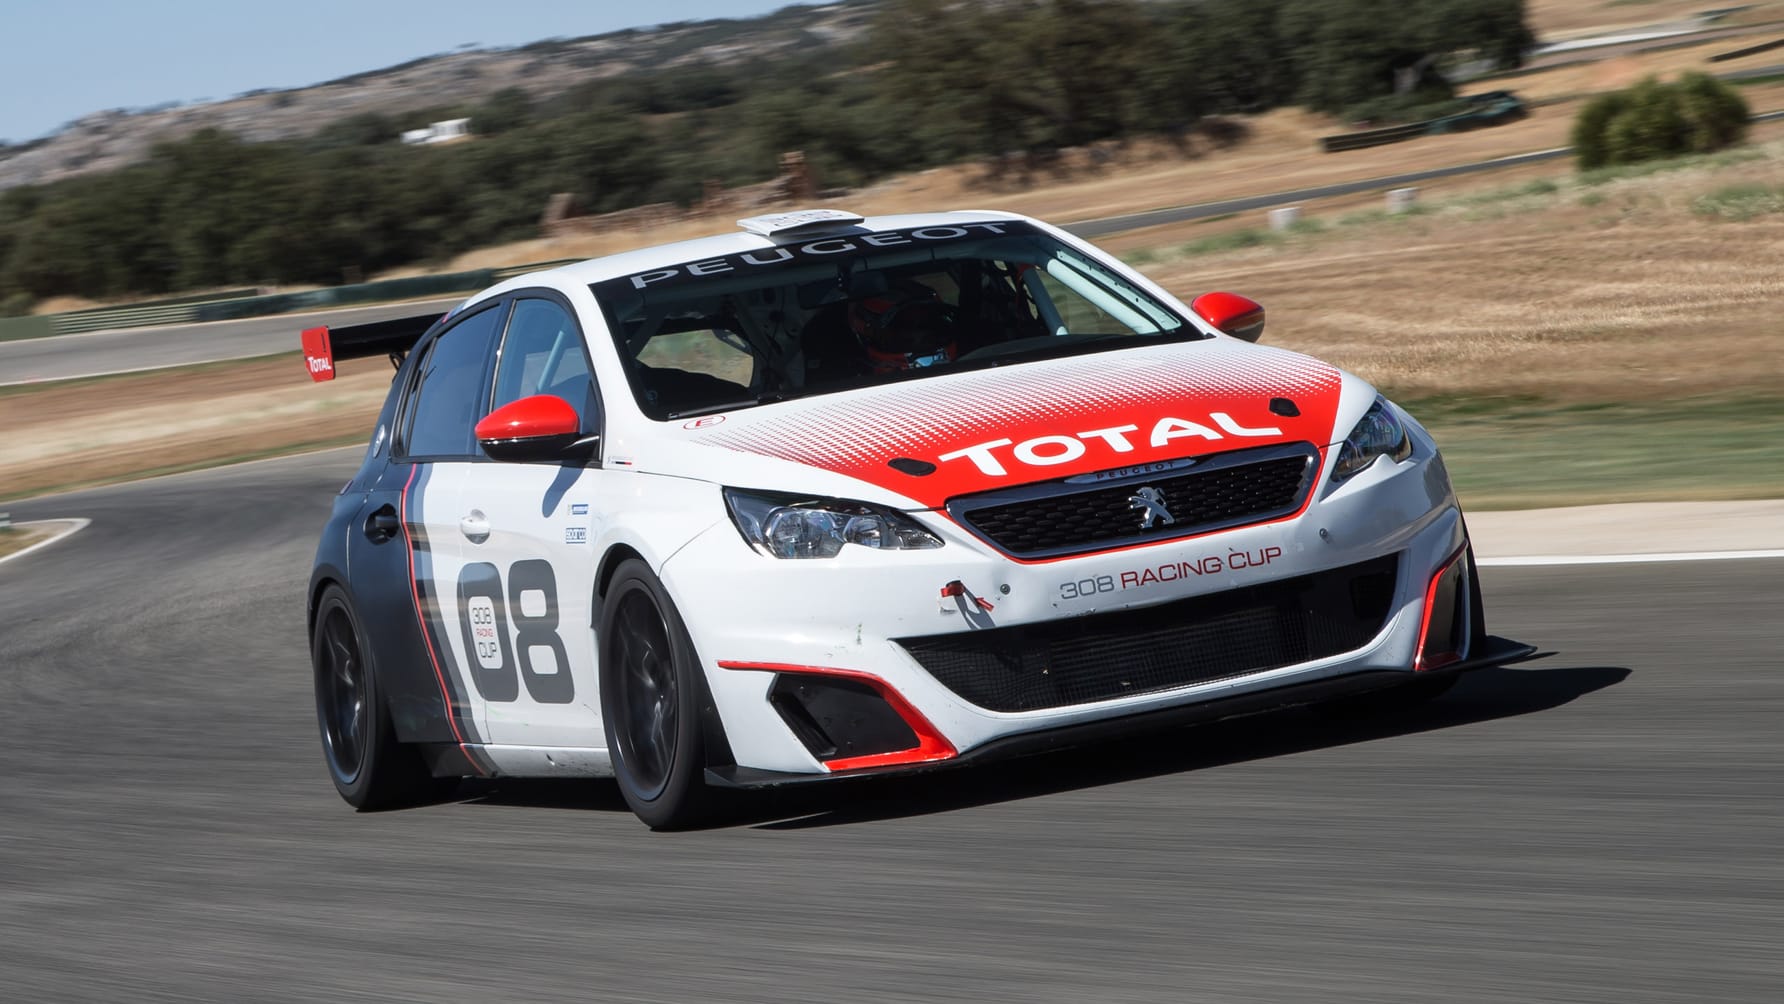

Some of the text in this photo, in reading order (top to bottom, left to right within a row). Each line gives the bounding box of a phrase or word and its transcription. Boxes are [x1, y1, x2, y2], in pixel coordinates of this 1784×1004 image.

[630, 222, 1008, 289] PEUGEOT
[308, 356, 331, 372] TOTAL
[938, 412, 1283, 477] TOTAL
[1096, 461, 1176, 480] PEUGEOT
[1059, 546, 1282, 600] 308 RACING CUP
[456, 558, 575, 704] 08
[472, 607, 491, 624] 308
[479, 642, 497, 658] CUP
